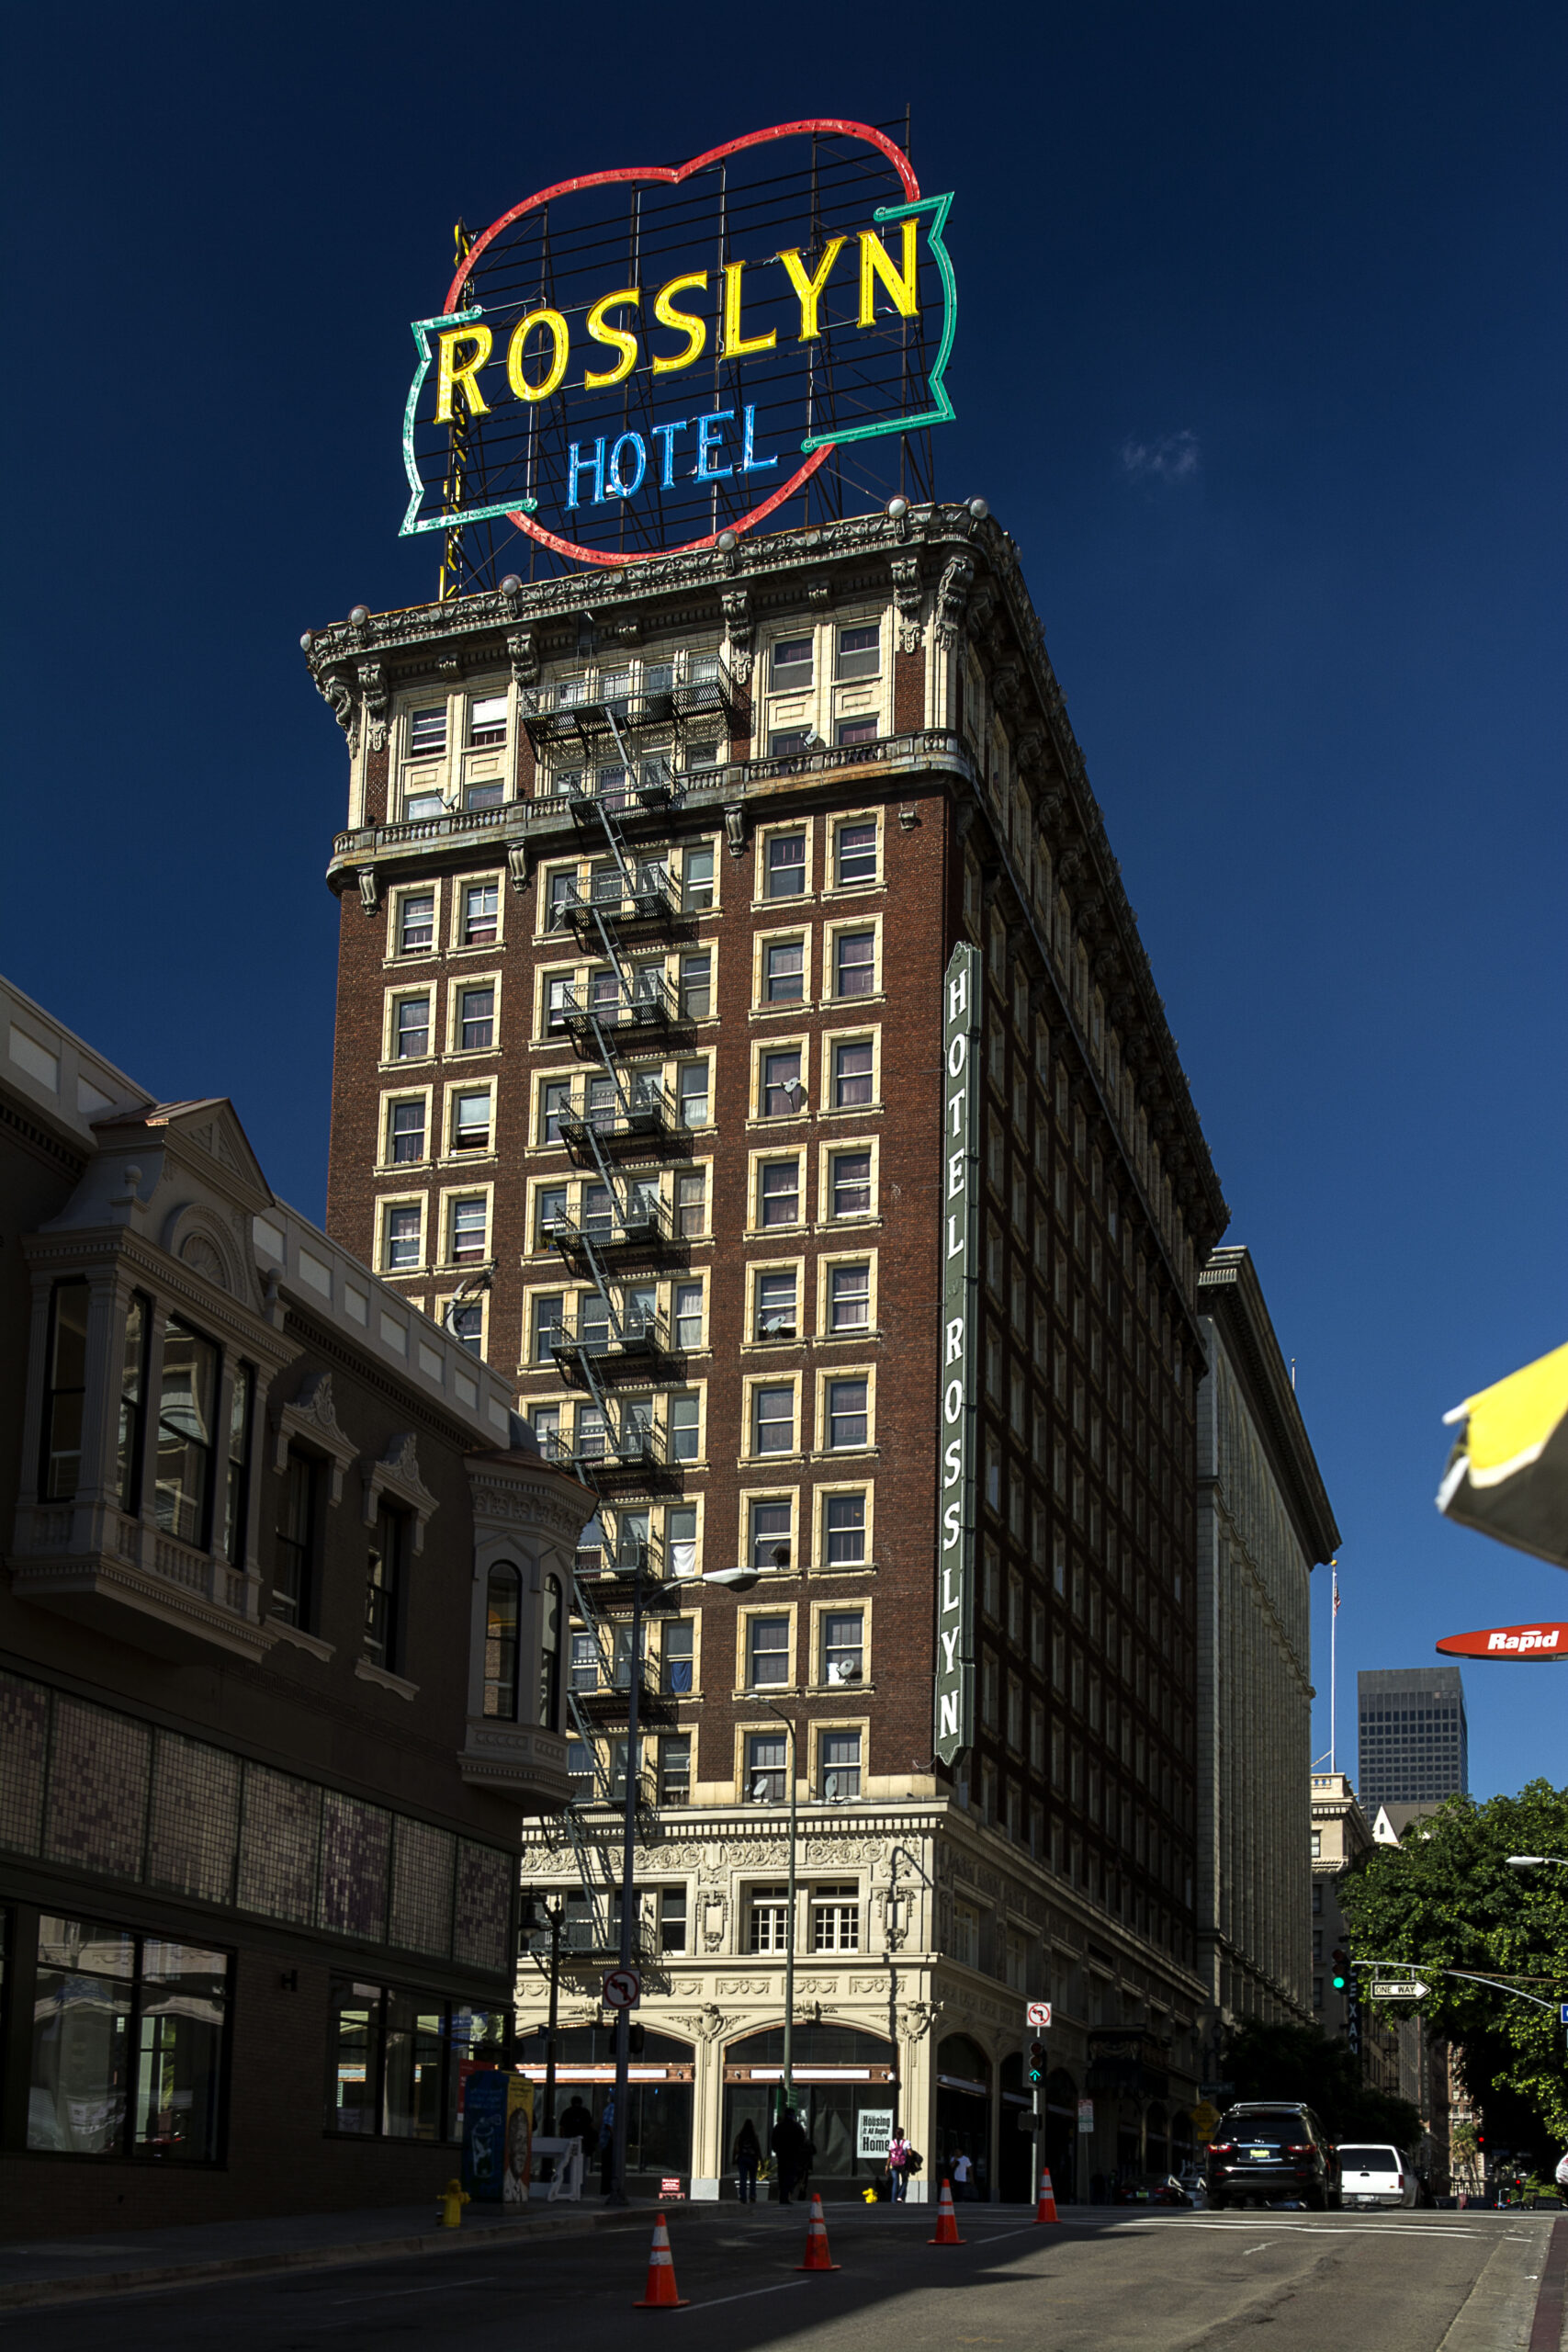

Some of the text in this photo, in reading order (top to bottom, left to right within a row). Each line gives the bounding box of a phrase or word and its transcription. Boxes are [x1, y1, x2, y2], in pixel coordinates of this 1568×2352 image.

[434, 219, 919, 425] ROSSLYN
[563, 403, 779, 511] HOTEL
[939, 968, 969, 1740] HOTEL ROSSLYN
[1487, 1630, 1560, 1652] Rapid
[1375, 1985, 1416, 1994] ONE WAY
[863, 2116, 890, 2128] Housing
[863, 2136, 889, 2152] Home
